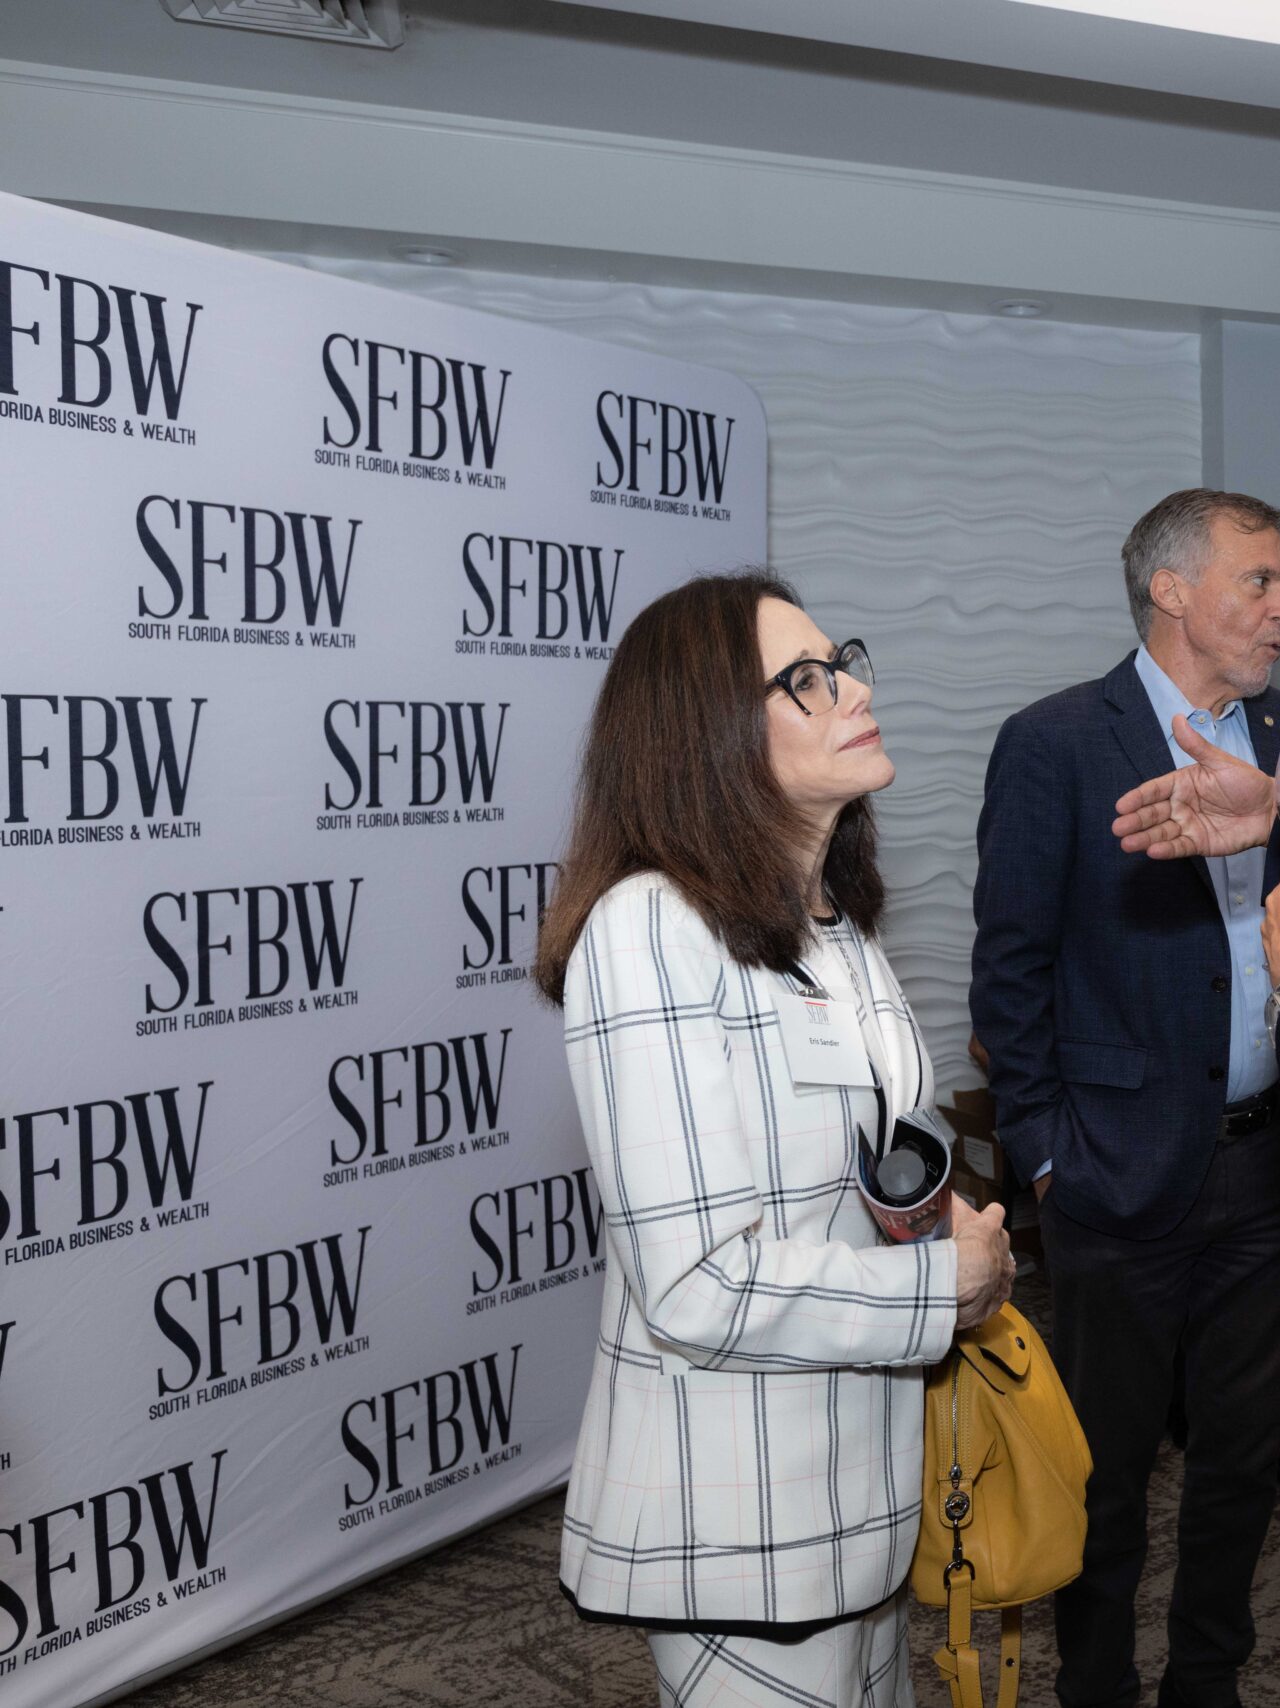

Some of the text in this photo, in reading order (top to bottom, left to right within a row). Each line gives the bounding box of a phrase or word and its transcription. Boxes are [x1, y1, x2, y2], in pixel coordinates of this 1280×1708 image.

[0, 261, 203, 420] FBW
[0, 399, 196, 446] ORIDA BUSINESS & WEALTH
[322, 333, 512, 469] SFBW
[597, 390, 735, 504] SFBW
[314, 448, 506, 490] SOUTH FLORIDA BUSINESS & WEALTH
[590, 489, 731, 522] SOUTH FLORIDA BUSINESS & WEALTH
[136, 495, 363, 627] SFBW
[463, 532, 624, 642] SFBW
[128, 622, 356, 649] SOUTH FLORIDA BUSINESS & WEALTH
[455, 639, 615, 661] SOUTH FLORIDA BUSINESS & WEALT
[1, 694, 208, 823] FBW
[324, 699, 510, 811] SFBW
[0, 821, 201, 848] LORIDA BUSINESS & WEALTH
[316, 807, 505, 831] SOUTH FLORIDA BUSINESS & WEALTH
[143, 877, 364, 1014] SFBW
[462, 863, 561, 970] SF
[135, 990, 359, 1037] SOUTH FLORIDA BUSINESS & WEALTH
[455, 971, 487, 990] SOUTH
[490, 966, 528, 985] FLORIDA
[328, 1028, 512, 1167] SFBW
[0, 1081, 214, 1241] FBW
[322, 1131, 510, 1188] SOUTH FLORIDA BUSINESS & WEALTH
[4, 1201, 210, 1266] FLORIDA BUSINESS & WEALTH
[154, 1225, 372, 1397] SFBW
[465, 1294, 497, 1316] SOUTH
[500, 1281, 538, 1305] FLORIDA
[538, 1267, 580, 1292] BUSINESS
[582, 1264, 590, 1278] &
[148, 1335, 370, 1421] SOUTH FLORIDA BUSINESS & WEALTH
[341, 1344, 523, 1510] SFBW
[338, 1443, 522, 1532] SOUTH FLORIDA BUSINESS & WEALTH
[23, 1626, 83, 1666] FLORIDA
[85, 1596, 151, 1638] BUSINESS
[156, 1591, 169, 1608] &
[172, 1565, 227, 1601] WEALTH
